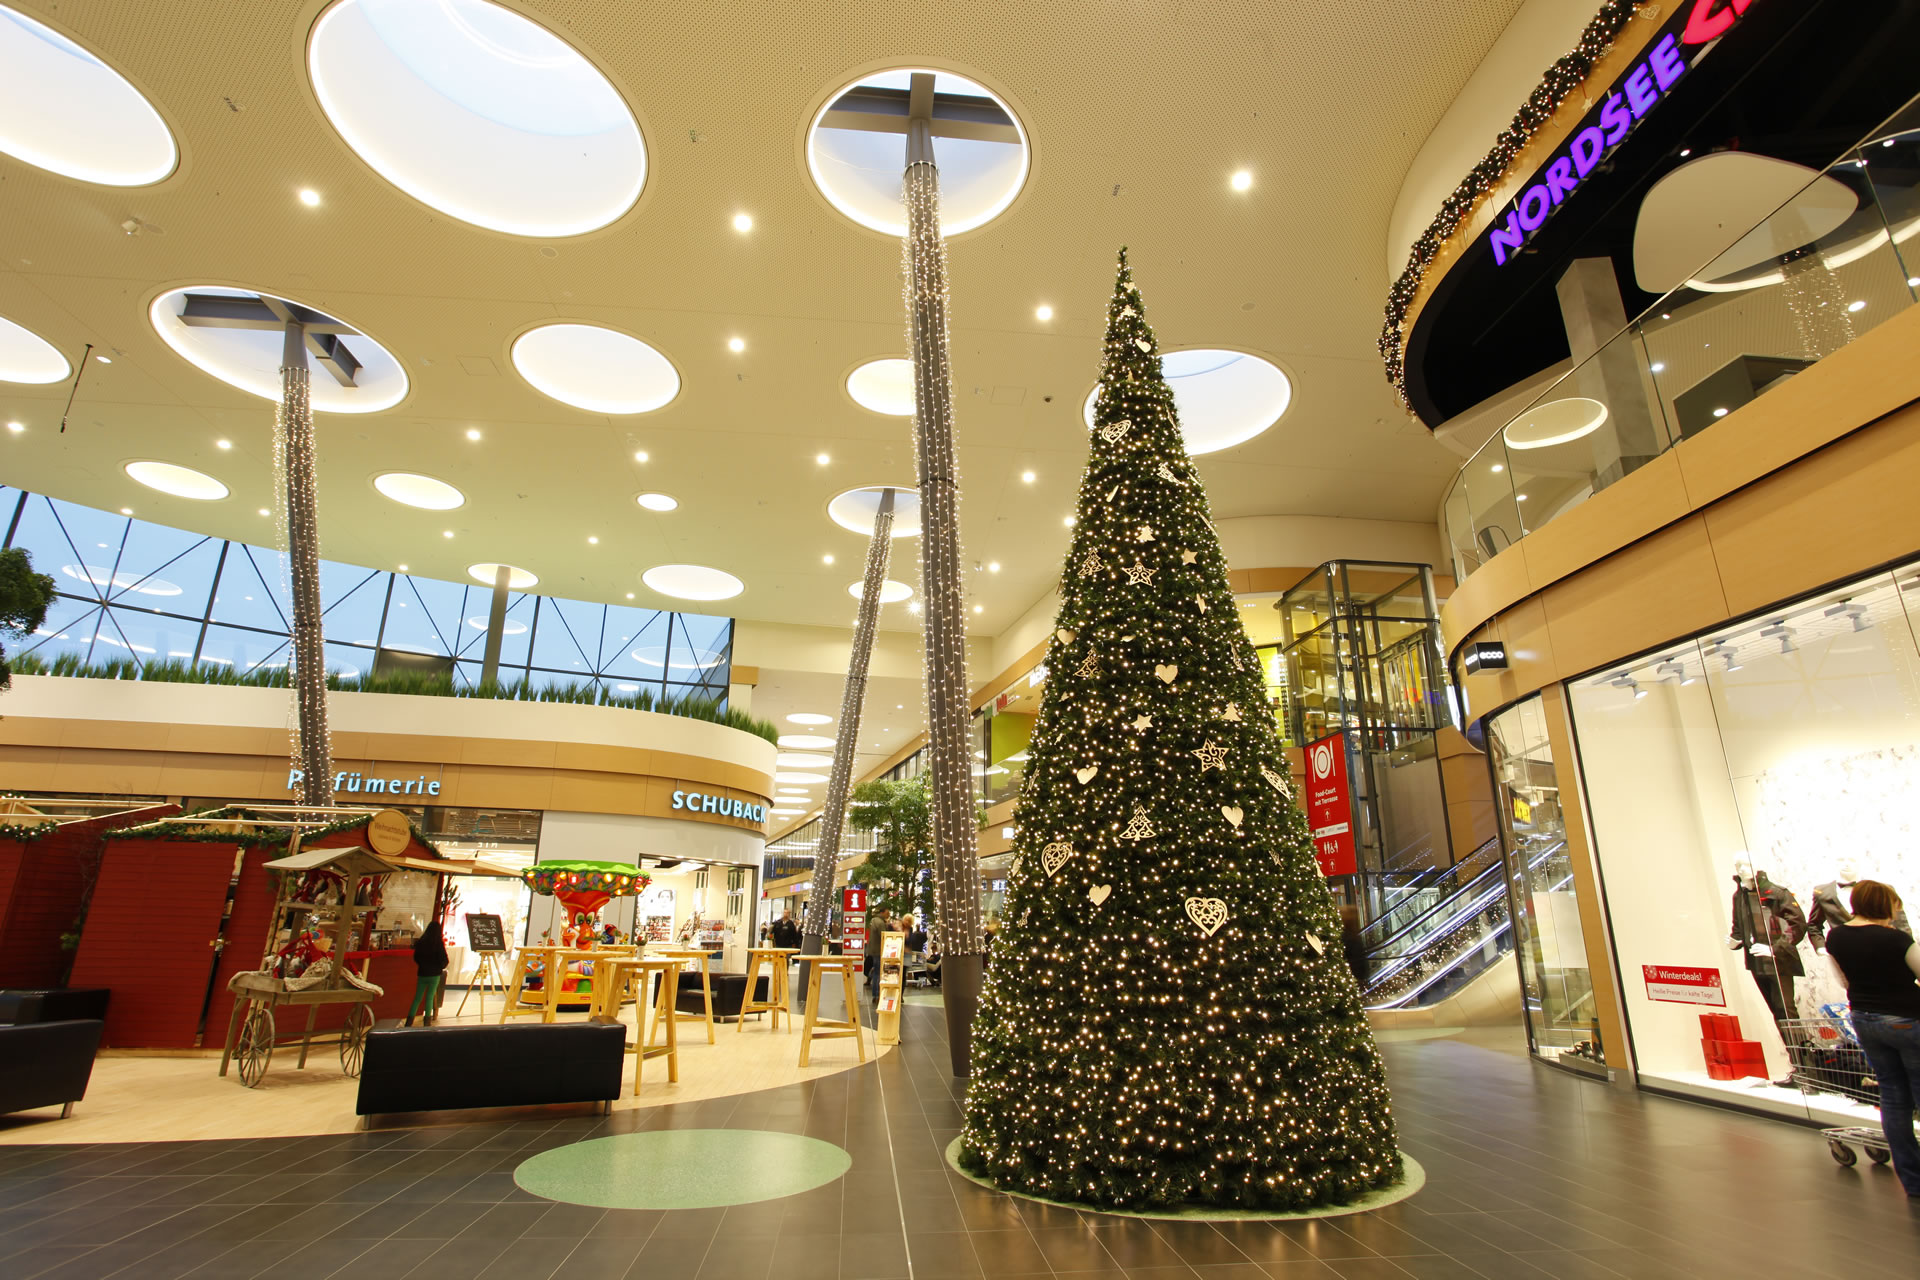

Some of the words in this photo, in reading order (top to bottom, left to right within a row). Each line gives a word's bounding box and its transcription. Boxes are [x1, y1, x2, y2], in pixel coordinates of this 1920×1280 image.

[1490, 33, 1686, 266] NORDSEE
[1479, 651, 1504, 660] ecco
[287, 768, 441, 796] Pfümerie
[672, 790, 767, 823] SCHUBACK
[1659, 970, 1702, 981] Winterdeals!
